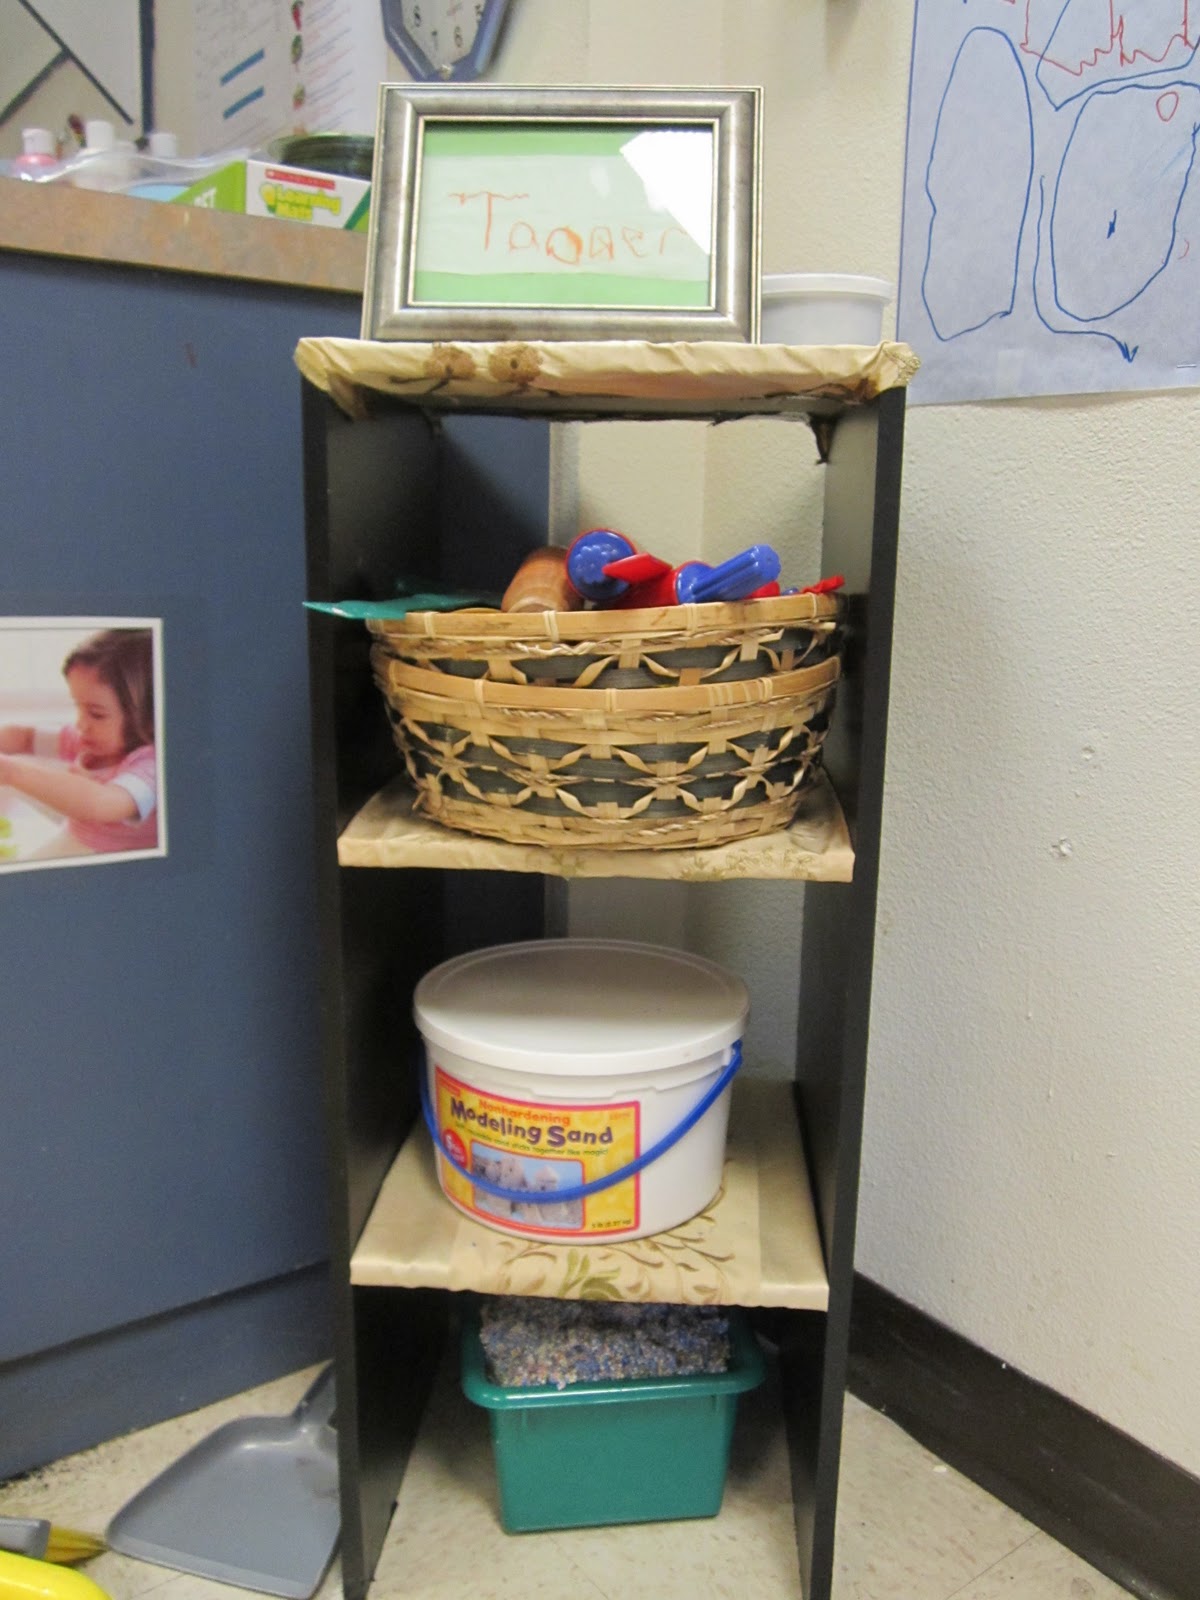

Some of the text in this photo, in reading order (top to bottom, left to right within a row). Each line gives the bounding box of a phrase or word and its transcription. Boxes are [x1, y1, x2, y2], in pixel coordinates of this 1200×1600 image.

[450, 1096, 541, 1145] Modeling
[547, 1125, 614, 1148] Sand
[478, 1099, 570, 1127] Nonhardening
